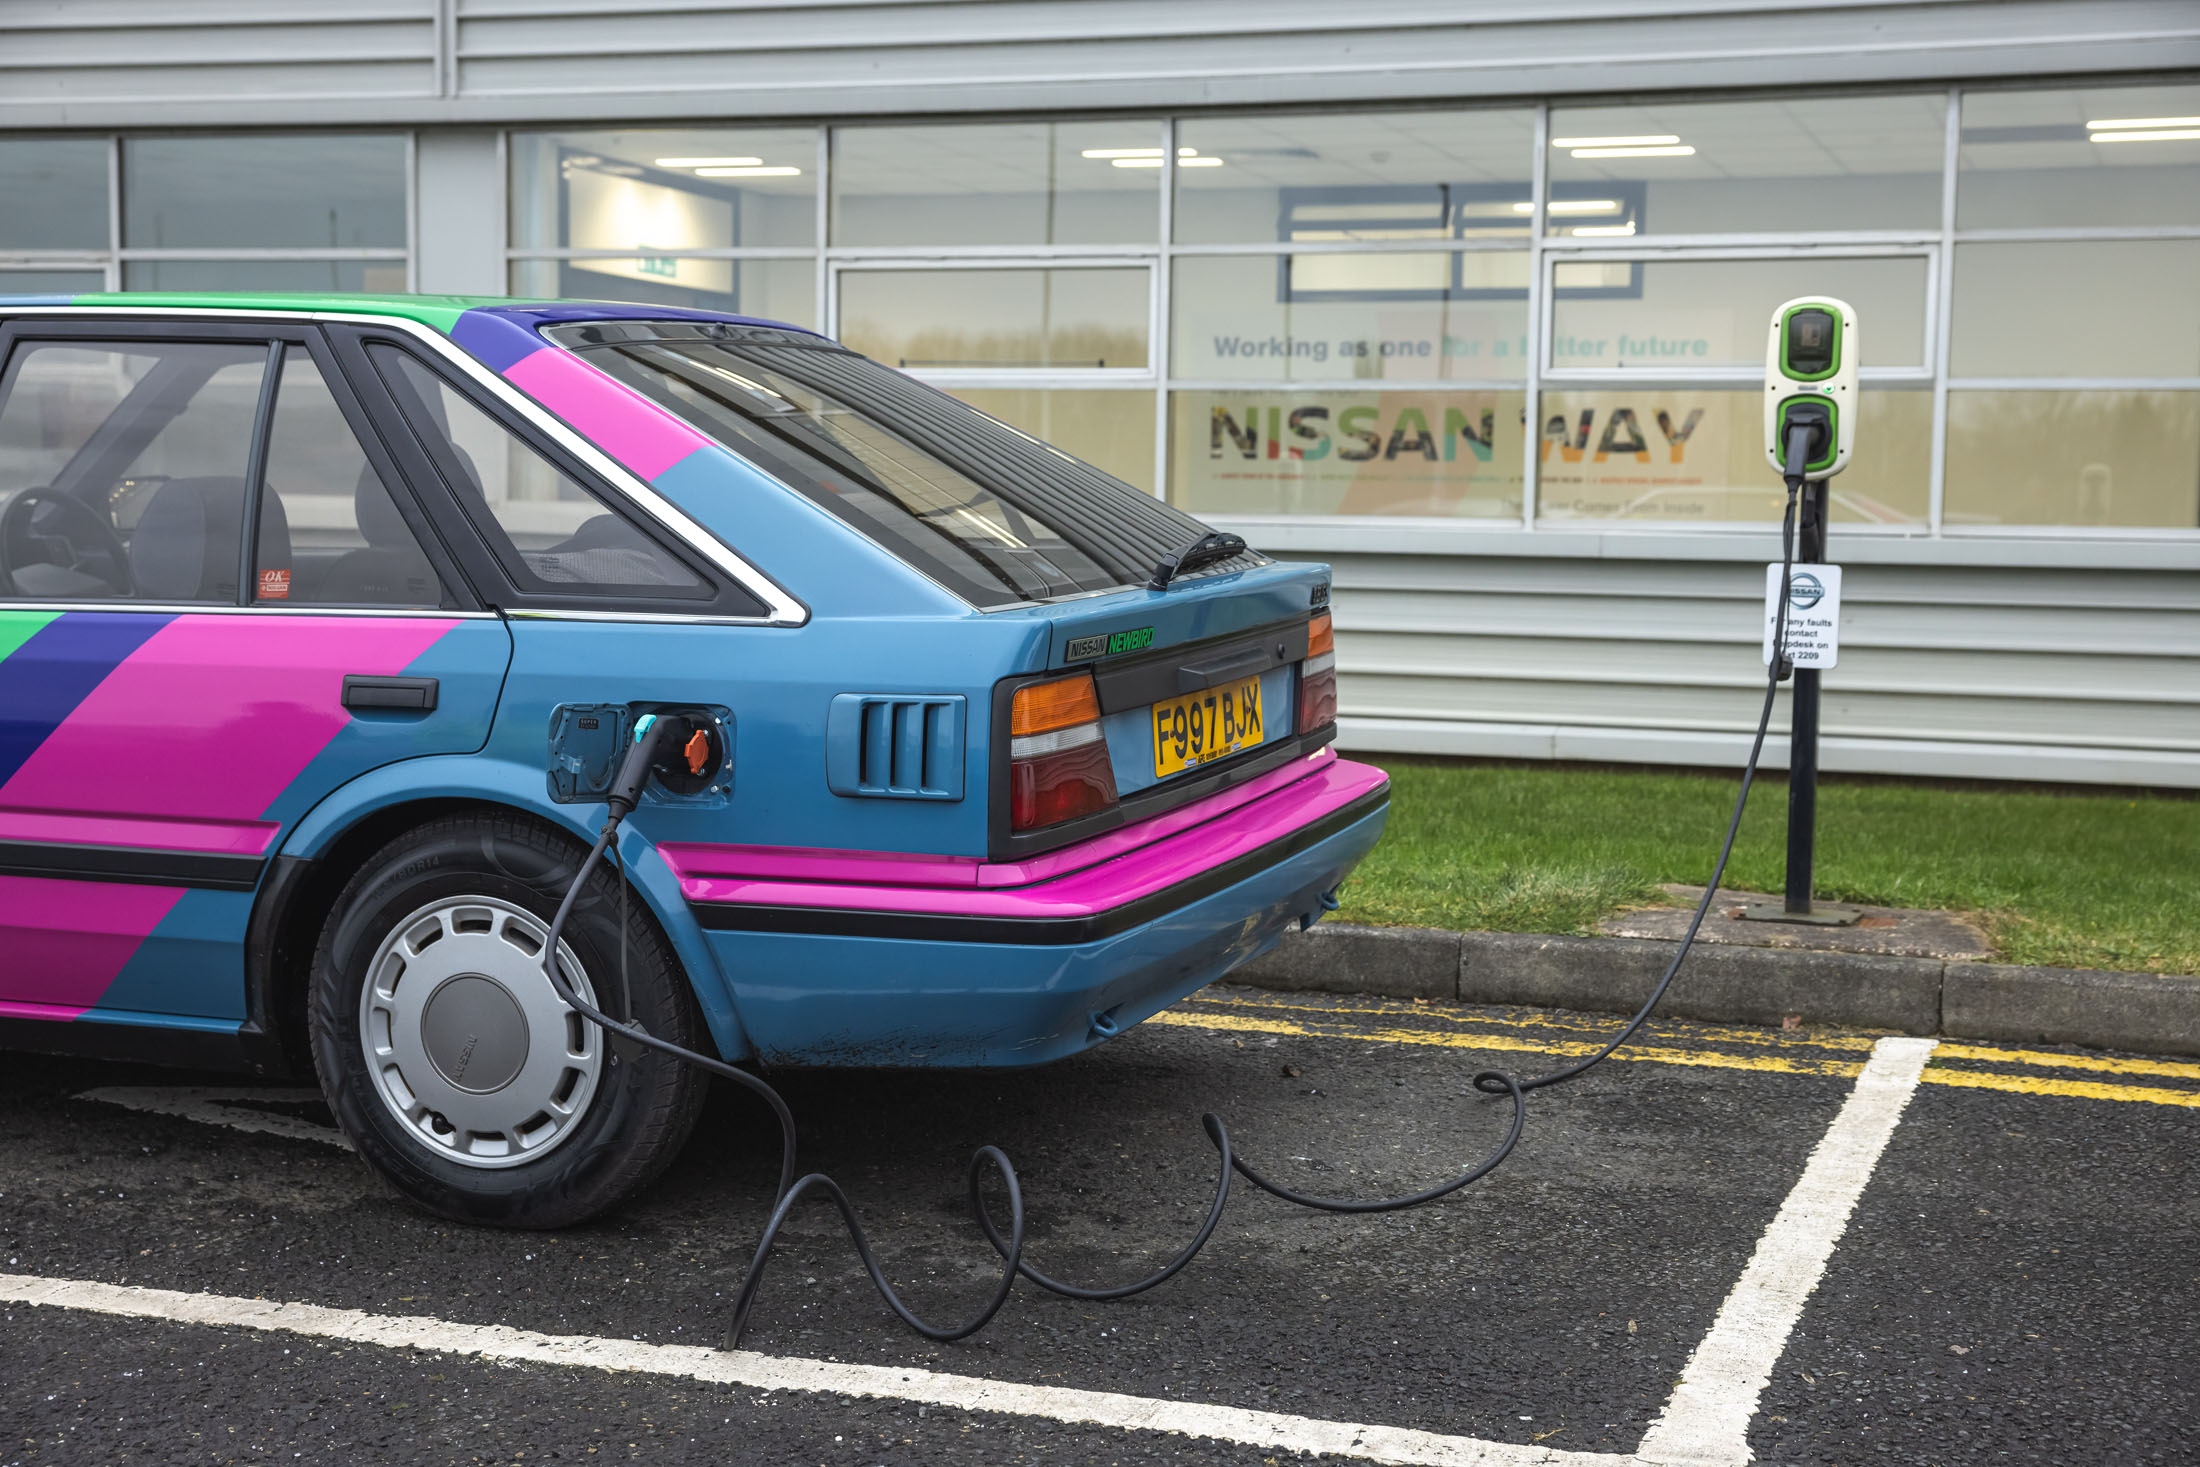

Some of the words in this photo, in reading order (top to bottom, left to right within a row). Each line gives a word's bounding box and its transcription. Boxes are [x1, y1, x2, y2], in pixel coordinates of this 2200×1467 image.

[1213, 336, 1329, 362] Working
[1339, 340, 1369, 357] as
[1378, 340, 1432, 357] one
[1441, 335, 1479, 357] for
[1493, 341, 1508, 357] a
[1617, 335, 1708, 357] future
[1210, 406, 1496, 462] NISSAN
[265, 571, 285, 583] OK
[1789, 619, 1805, 627] any
[1807, 619, 1832, 627] faults
[1071, 638, 1105, 657] NISSAN
[1108, 627, 1155, 654] NEWBIRD
[1157, 696, 1217, 765] F997
[1222, 683, 1261, 744] BJX
